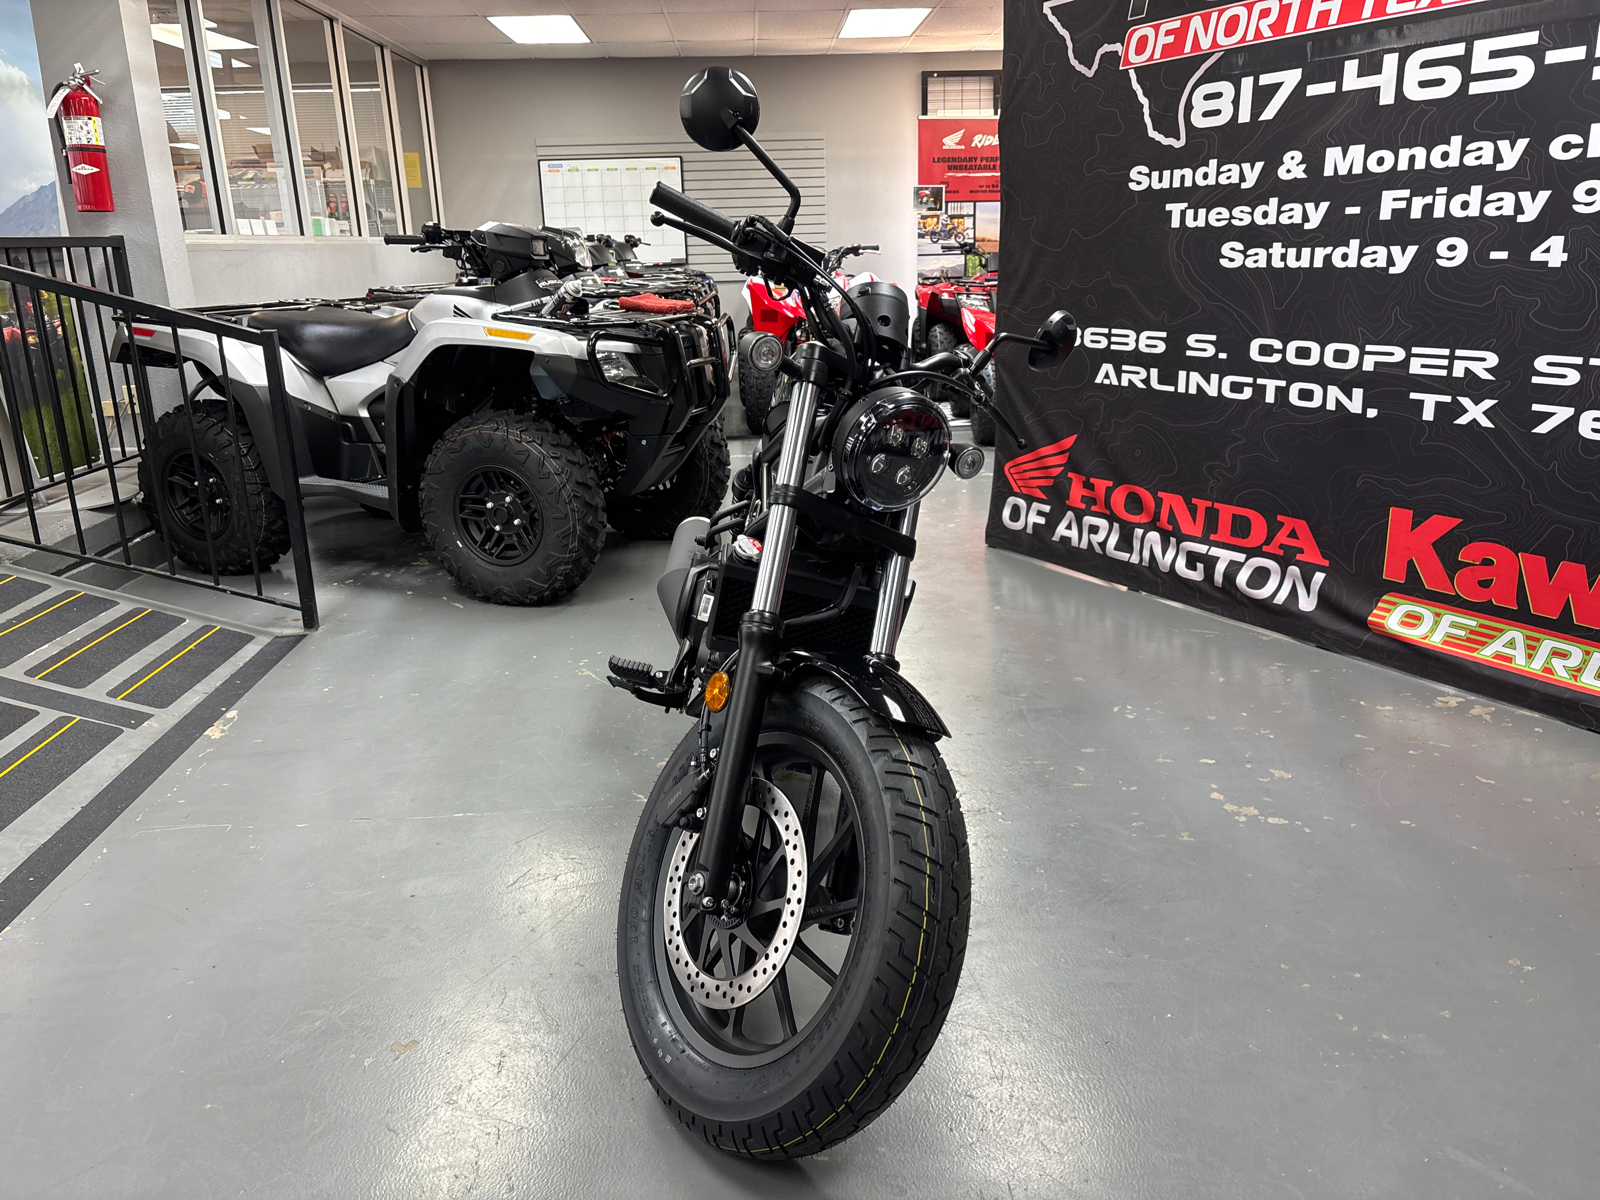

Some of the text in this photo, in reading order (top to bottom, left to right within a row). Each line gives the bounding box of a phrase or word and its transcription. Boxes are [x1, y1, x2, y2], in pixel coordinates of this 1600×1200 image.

[1126, 20, 1181, 69] OF
[1185, 0, 1345, 53] NORTH
[1190, 25, 1600, 128] 817-465-
[1128, 159, 1264, 191] Sunday
[1278, 151, 1307, 180] &
[1324, 135, 1530, 176] Monday
[1166, 197, 1330, 229] Tuesday
[1344, 206, 1362, 215] -
[1379, 185, 1552, 222] Friday
[1219, 236, 1568, 274] Saturday 9 - 4
[1074, 324, 1168, 353] 636
[1186, 334, 1227, 359] S.
[1250, 338, 1499, 380] COOPER
[1095, 363, 1377, 418] ARLINGTON,
[1410, 392, 1498, 428] TX
[1066, 472, 1329, 566] HONDA
[1002, 497, 1327, 612] OF ARLINGTON
[1387, 605, 1478, 643] OF
